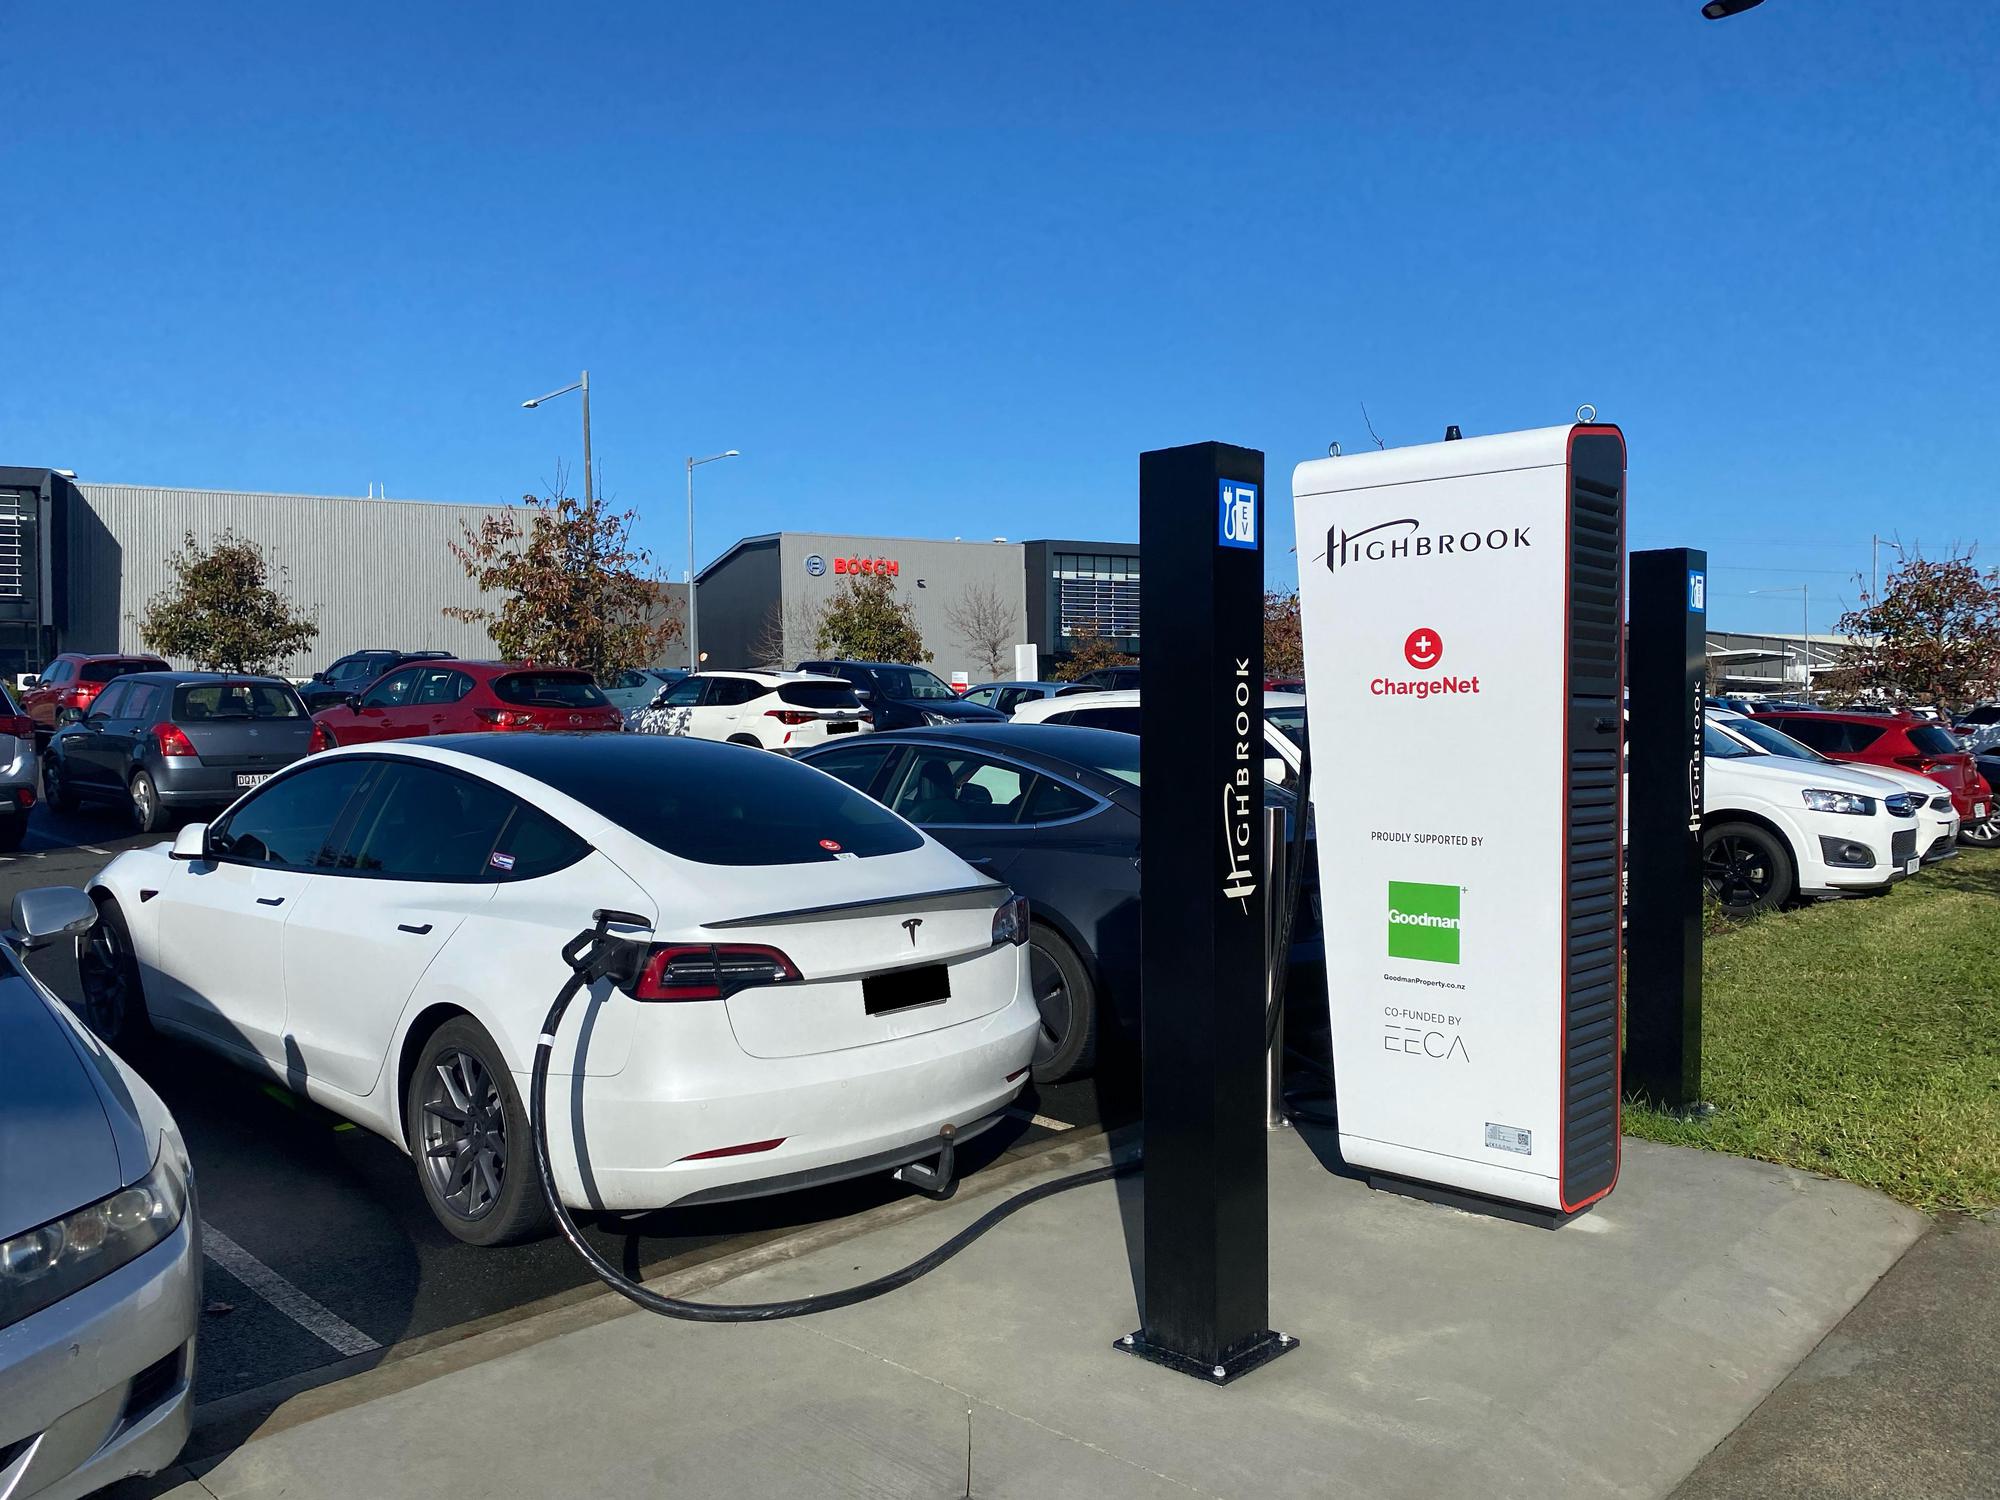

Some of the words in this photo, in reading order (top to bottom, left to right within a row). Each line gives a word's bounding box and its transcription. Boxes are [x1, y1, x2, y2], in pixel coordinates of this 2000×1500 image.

[1241, 505, 1249, 536] EV
[1312, 518, 1532, 574] HIGHBROOK
[834, 557, 899, 577] BOSCH
[1370, 676, 1480, 699] ChargeNet
[1688, 680, 1702, 842] HIGHBROOK
[238, 775, 272, 786] DQA1
[1222, 657, 1257, 916] HIGHBROOK
[1371, 831, 1411, 843] PROUDLY
[1414, 833, 1468, 846] SUPPORTED
[1471, 836, 1484, 847] BY
[1388, 908, 1461, 930] Goodman
[1383, 973, 1466, 990] GoodmanProperty.co.nz
[1384, 1006, 1445, 1024] CO-FUNDED
[1448, 1015, 1462, 1026] BY
[1384, 1024, 1470, 1063] EECA
